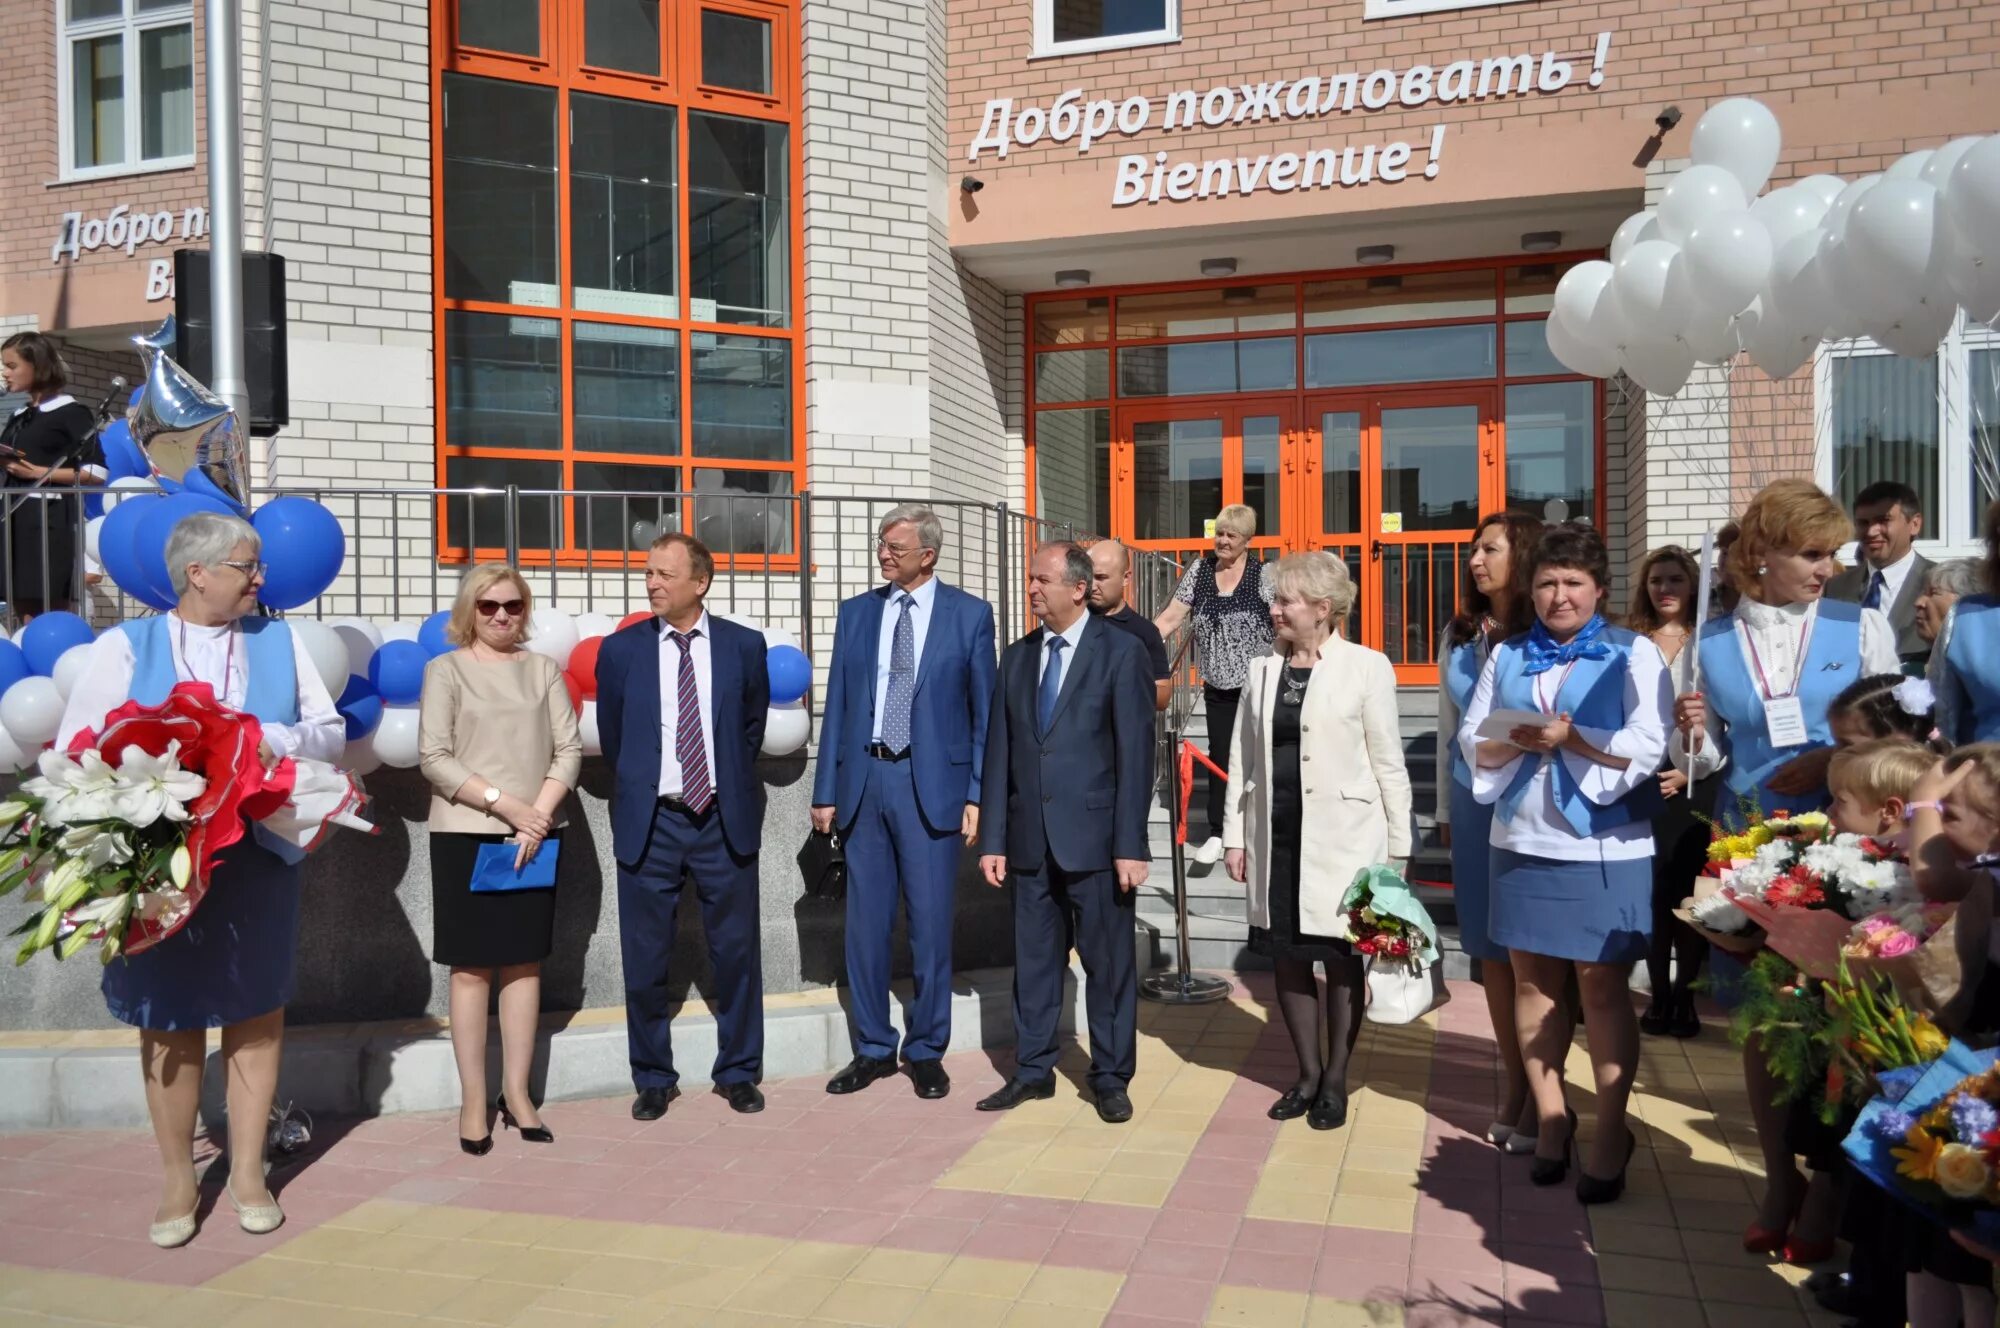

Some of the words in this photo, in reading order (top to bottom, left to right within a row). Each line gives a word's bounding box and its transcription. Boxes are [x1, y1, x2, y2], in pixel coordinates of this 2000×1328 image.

[968, 88, 1150, 160] Добро
[1162, 52, 1573, 130] пожаловать
[1112, 142, 1412, 205] Bienvenue
[52, 204, 174, 263] Добро
